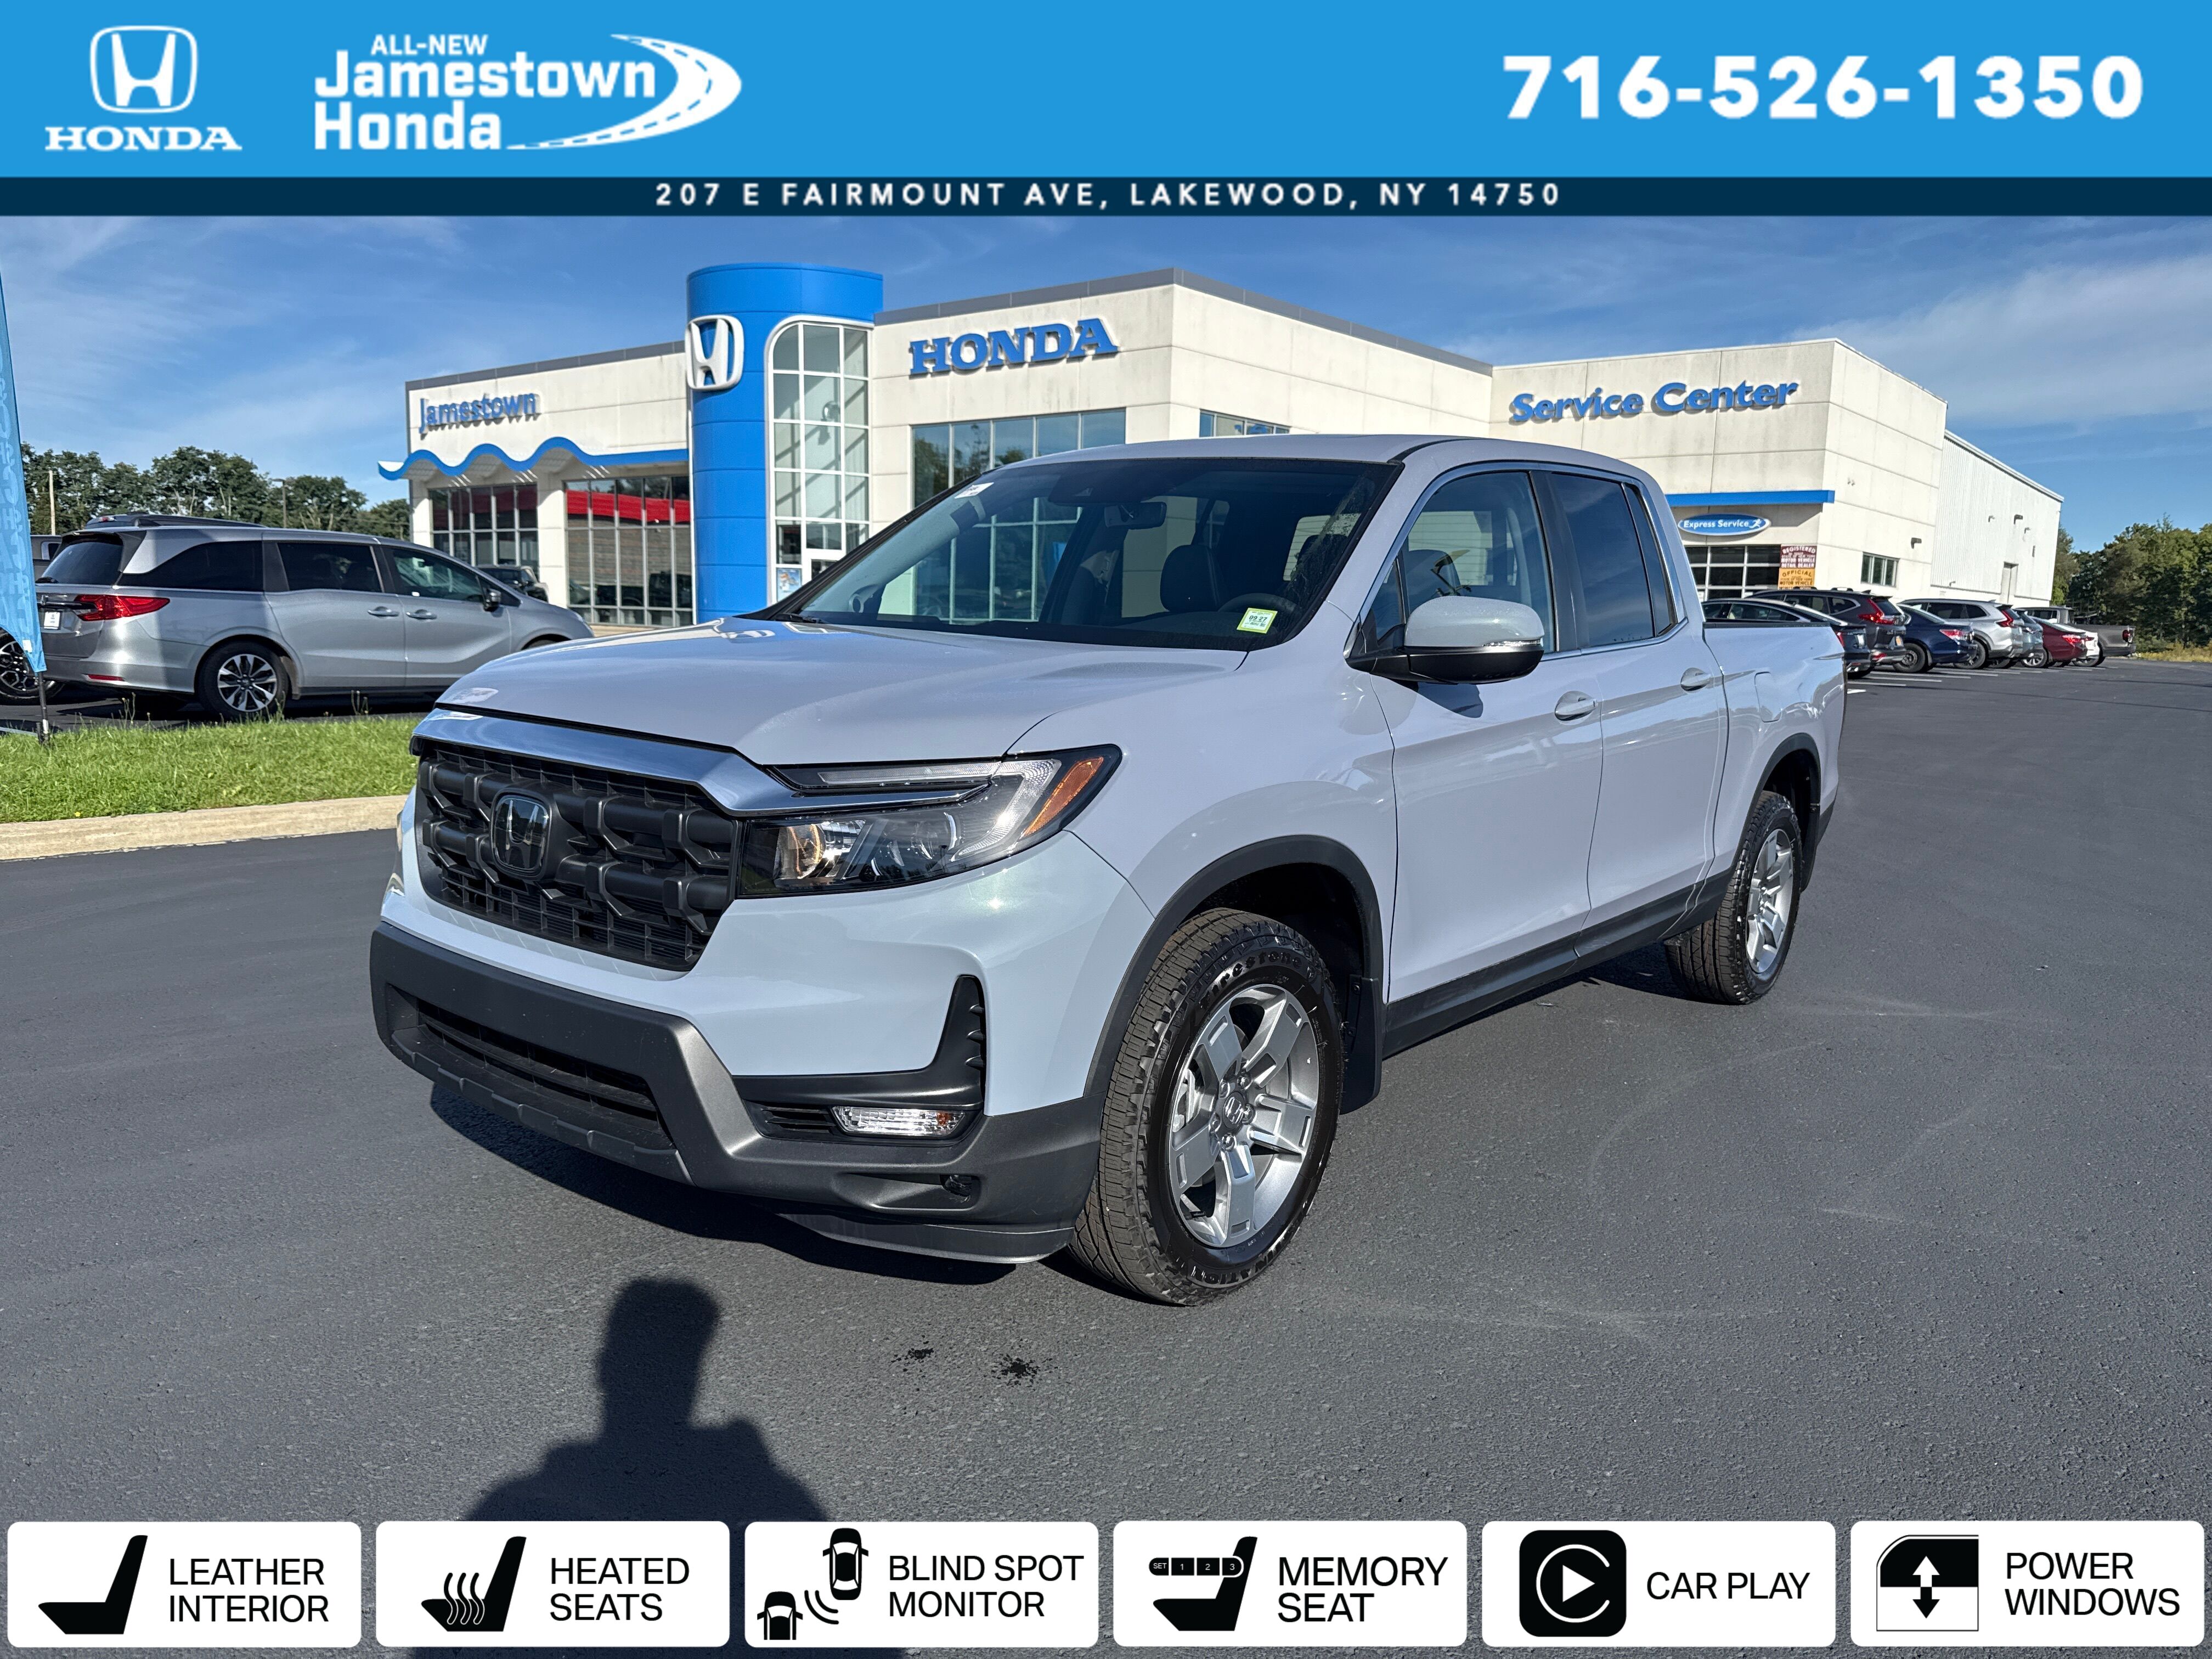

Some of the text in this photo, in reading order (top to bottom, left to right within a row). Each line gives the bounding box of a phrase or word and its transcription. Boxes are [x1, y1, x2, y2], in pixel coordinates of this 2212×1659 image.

[910, 318, 1119, 375] HONDA
[419, 393, 538, 433] Jamestown
[1513, 380, 1798, 422] Service Center
[1684, 520, 1750, 529] Express Service
